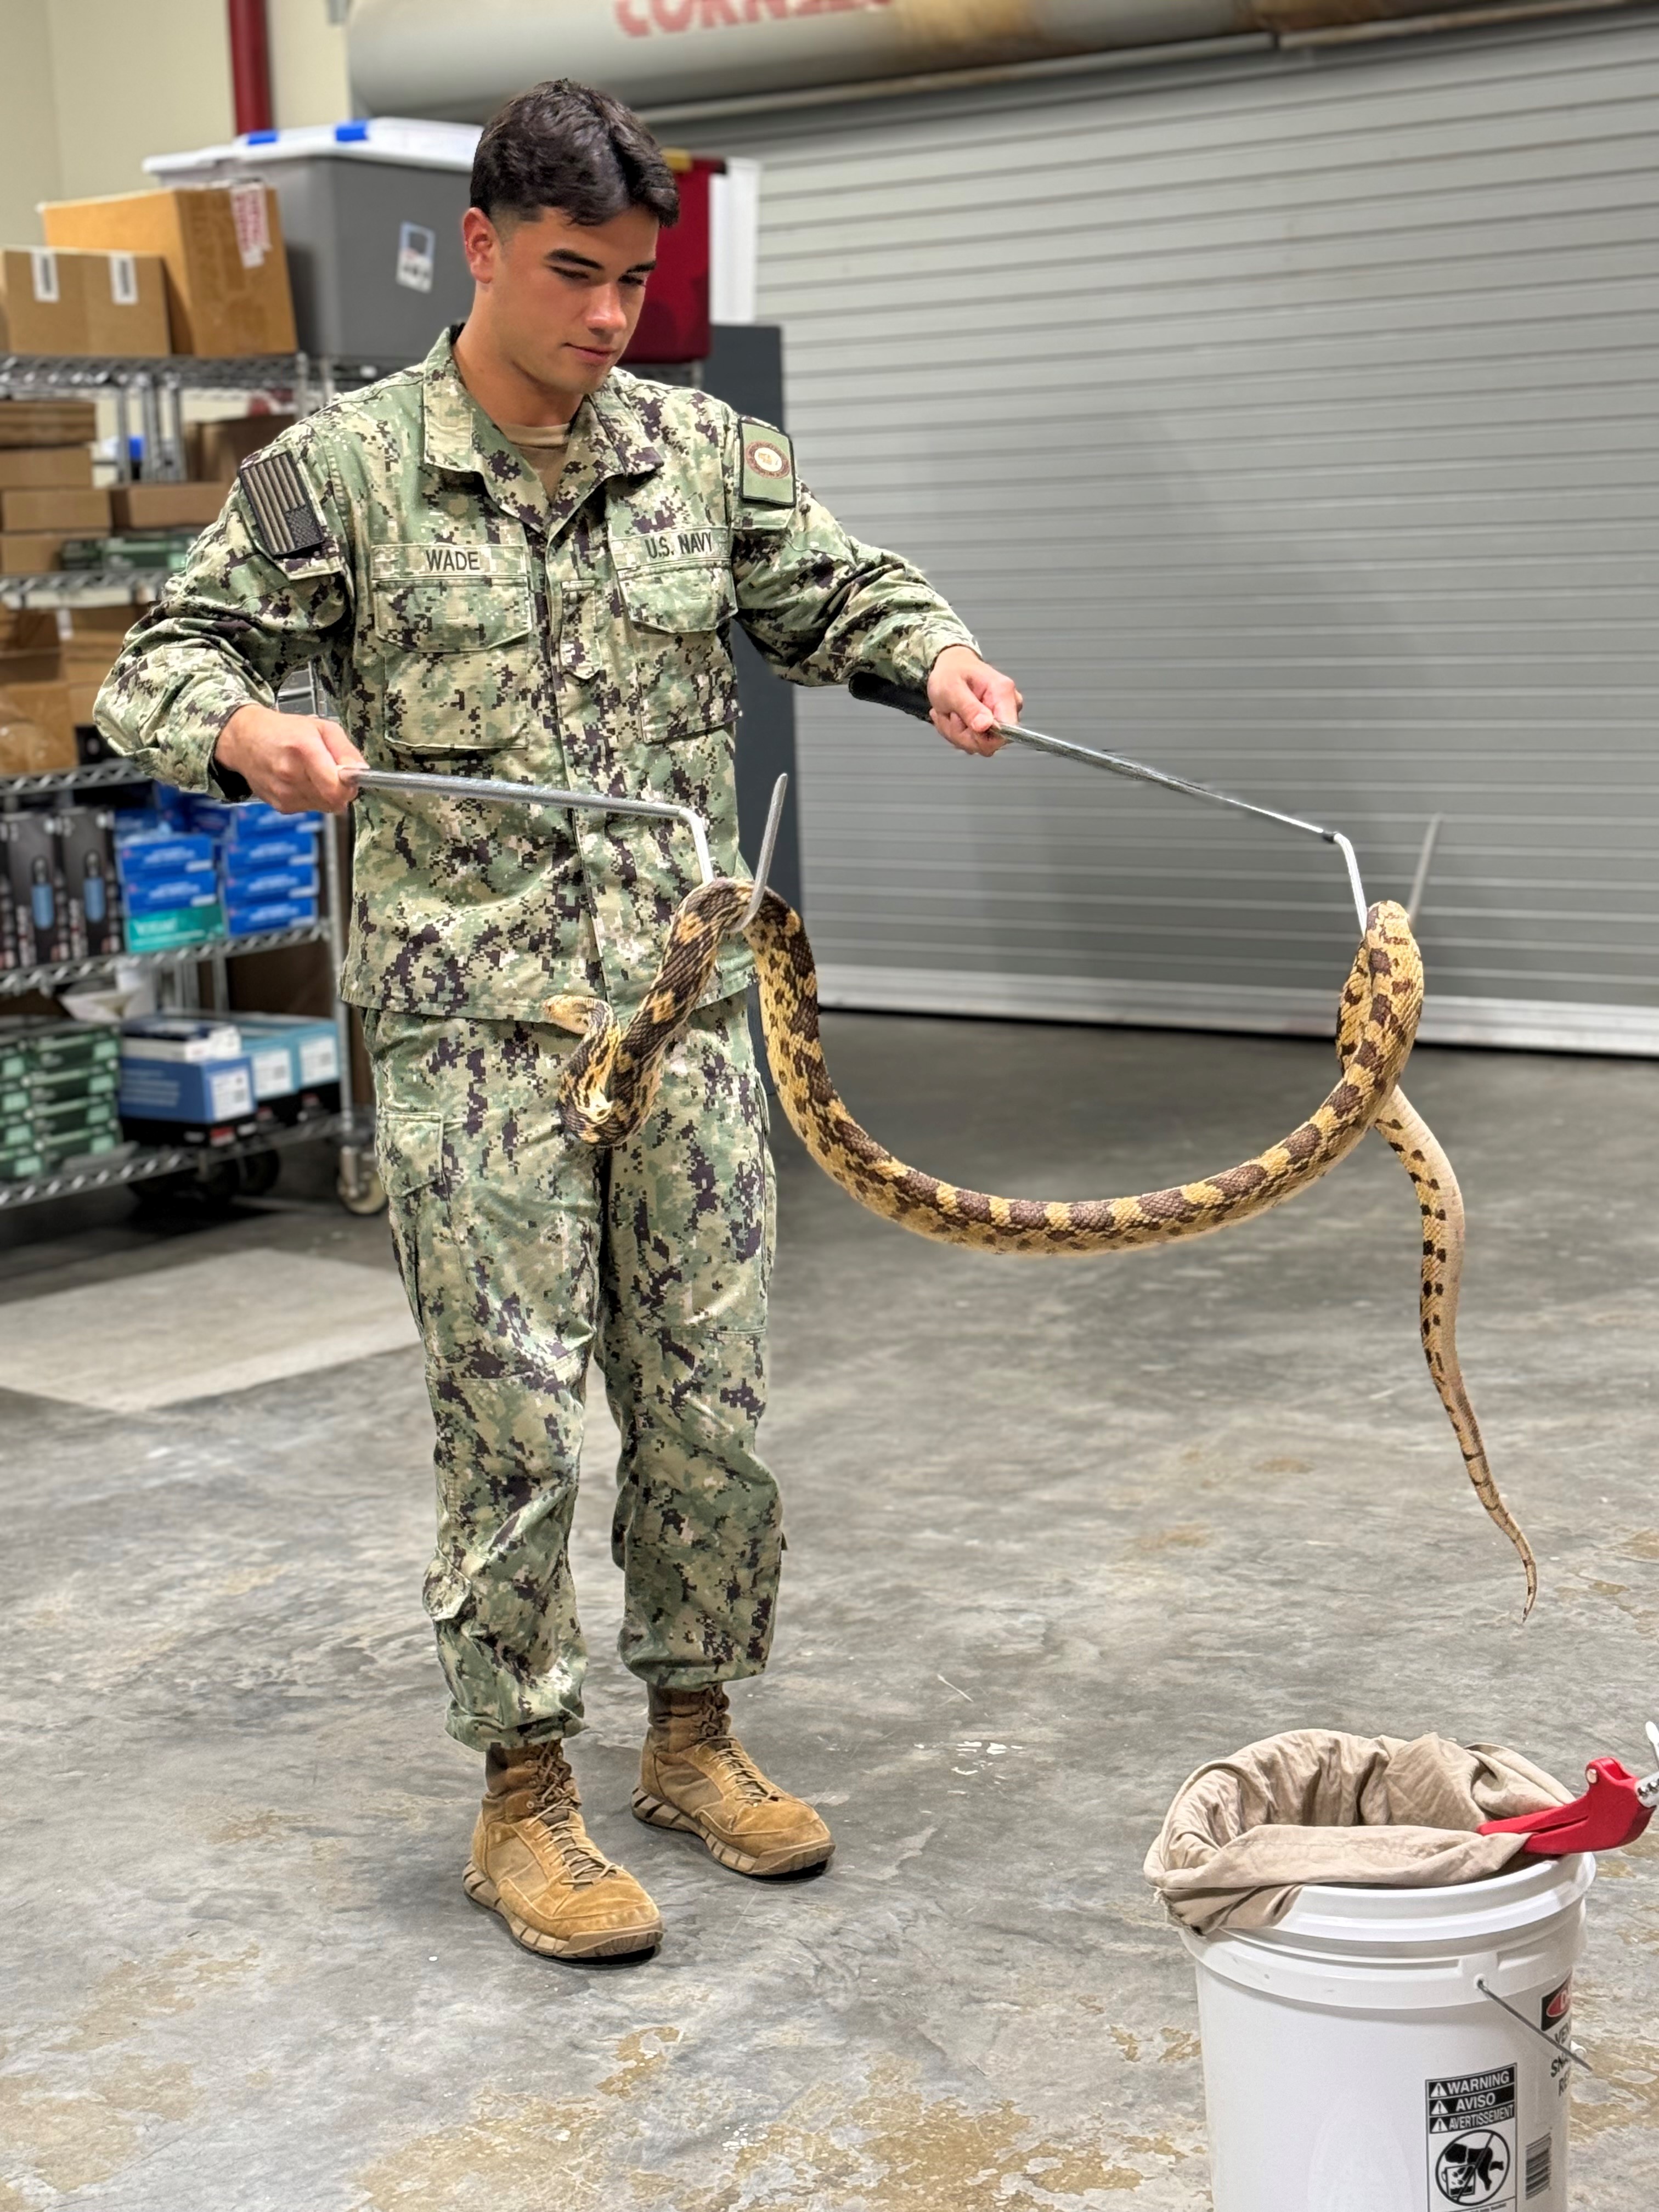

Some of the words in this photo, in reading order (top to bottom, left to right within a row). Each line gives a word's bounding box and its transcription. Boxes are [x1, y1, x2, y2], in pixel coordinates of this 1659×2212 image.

[644, 535, 675, 559] U.S.
[678, 531, 712, 555] NAVY
[425, 549, 481, 571] WADE
[1447, 2070, 1510, 2095] WARNING
[1455, 2092, 1496, 2112] AVISO
[1449, 2104, 1514, 2131] AVERTISSEMENT
